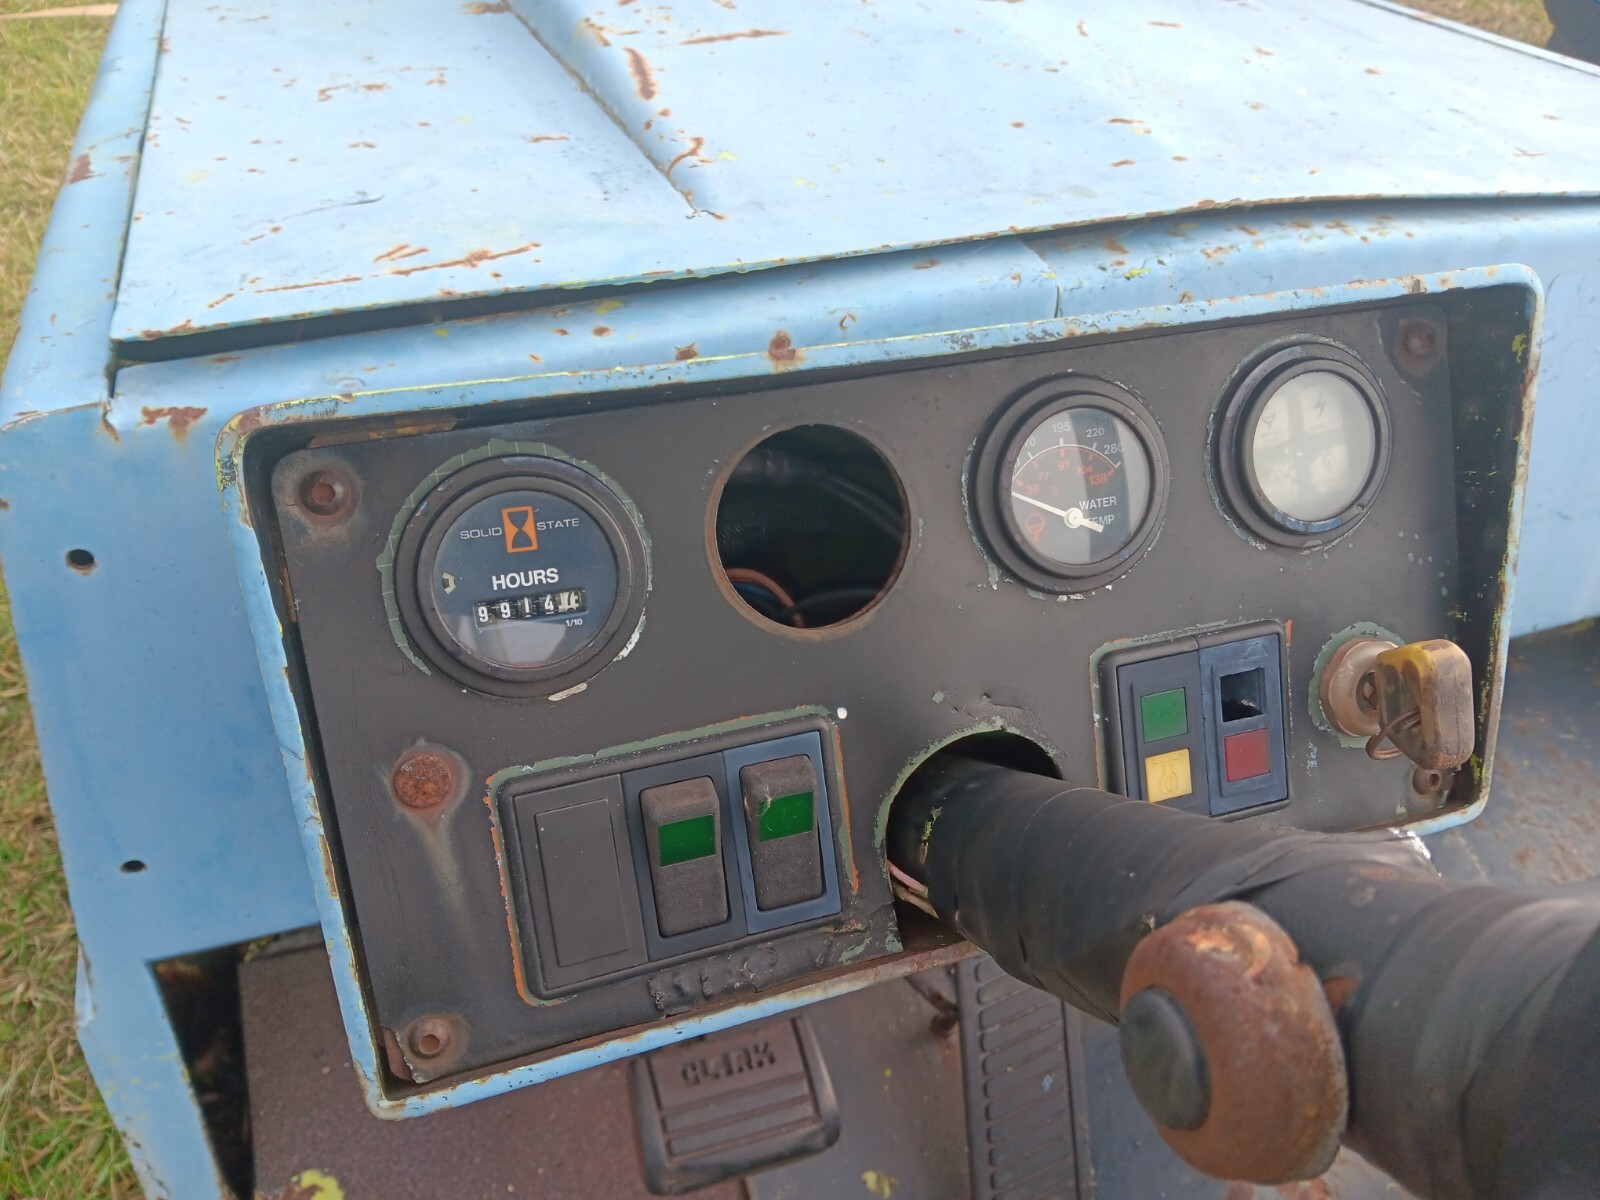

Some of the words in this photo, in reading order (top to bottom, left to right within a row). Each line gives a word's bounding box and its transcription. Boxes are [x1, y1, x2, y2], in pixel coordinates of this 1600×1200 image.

[1052, 423, 1071, 433] 195
[1086, 427, 1105, 438] 220
[1104, 443, 1125, 455] 280
[1057, 460, 1070, 472] 91
[1088, 474, 1108, 486] 138
[1078, 495, 1117, 511] WATER
[460, 526, 502, 540] SOLID
[537, 518, 580, 531] STATE
[1087, 514, 1115, 526] EMP
[492, 567, 559, 591] HOURS
[565, 618, 583, 627] 1/10
